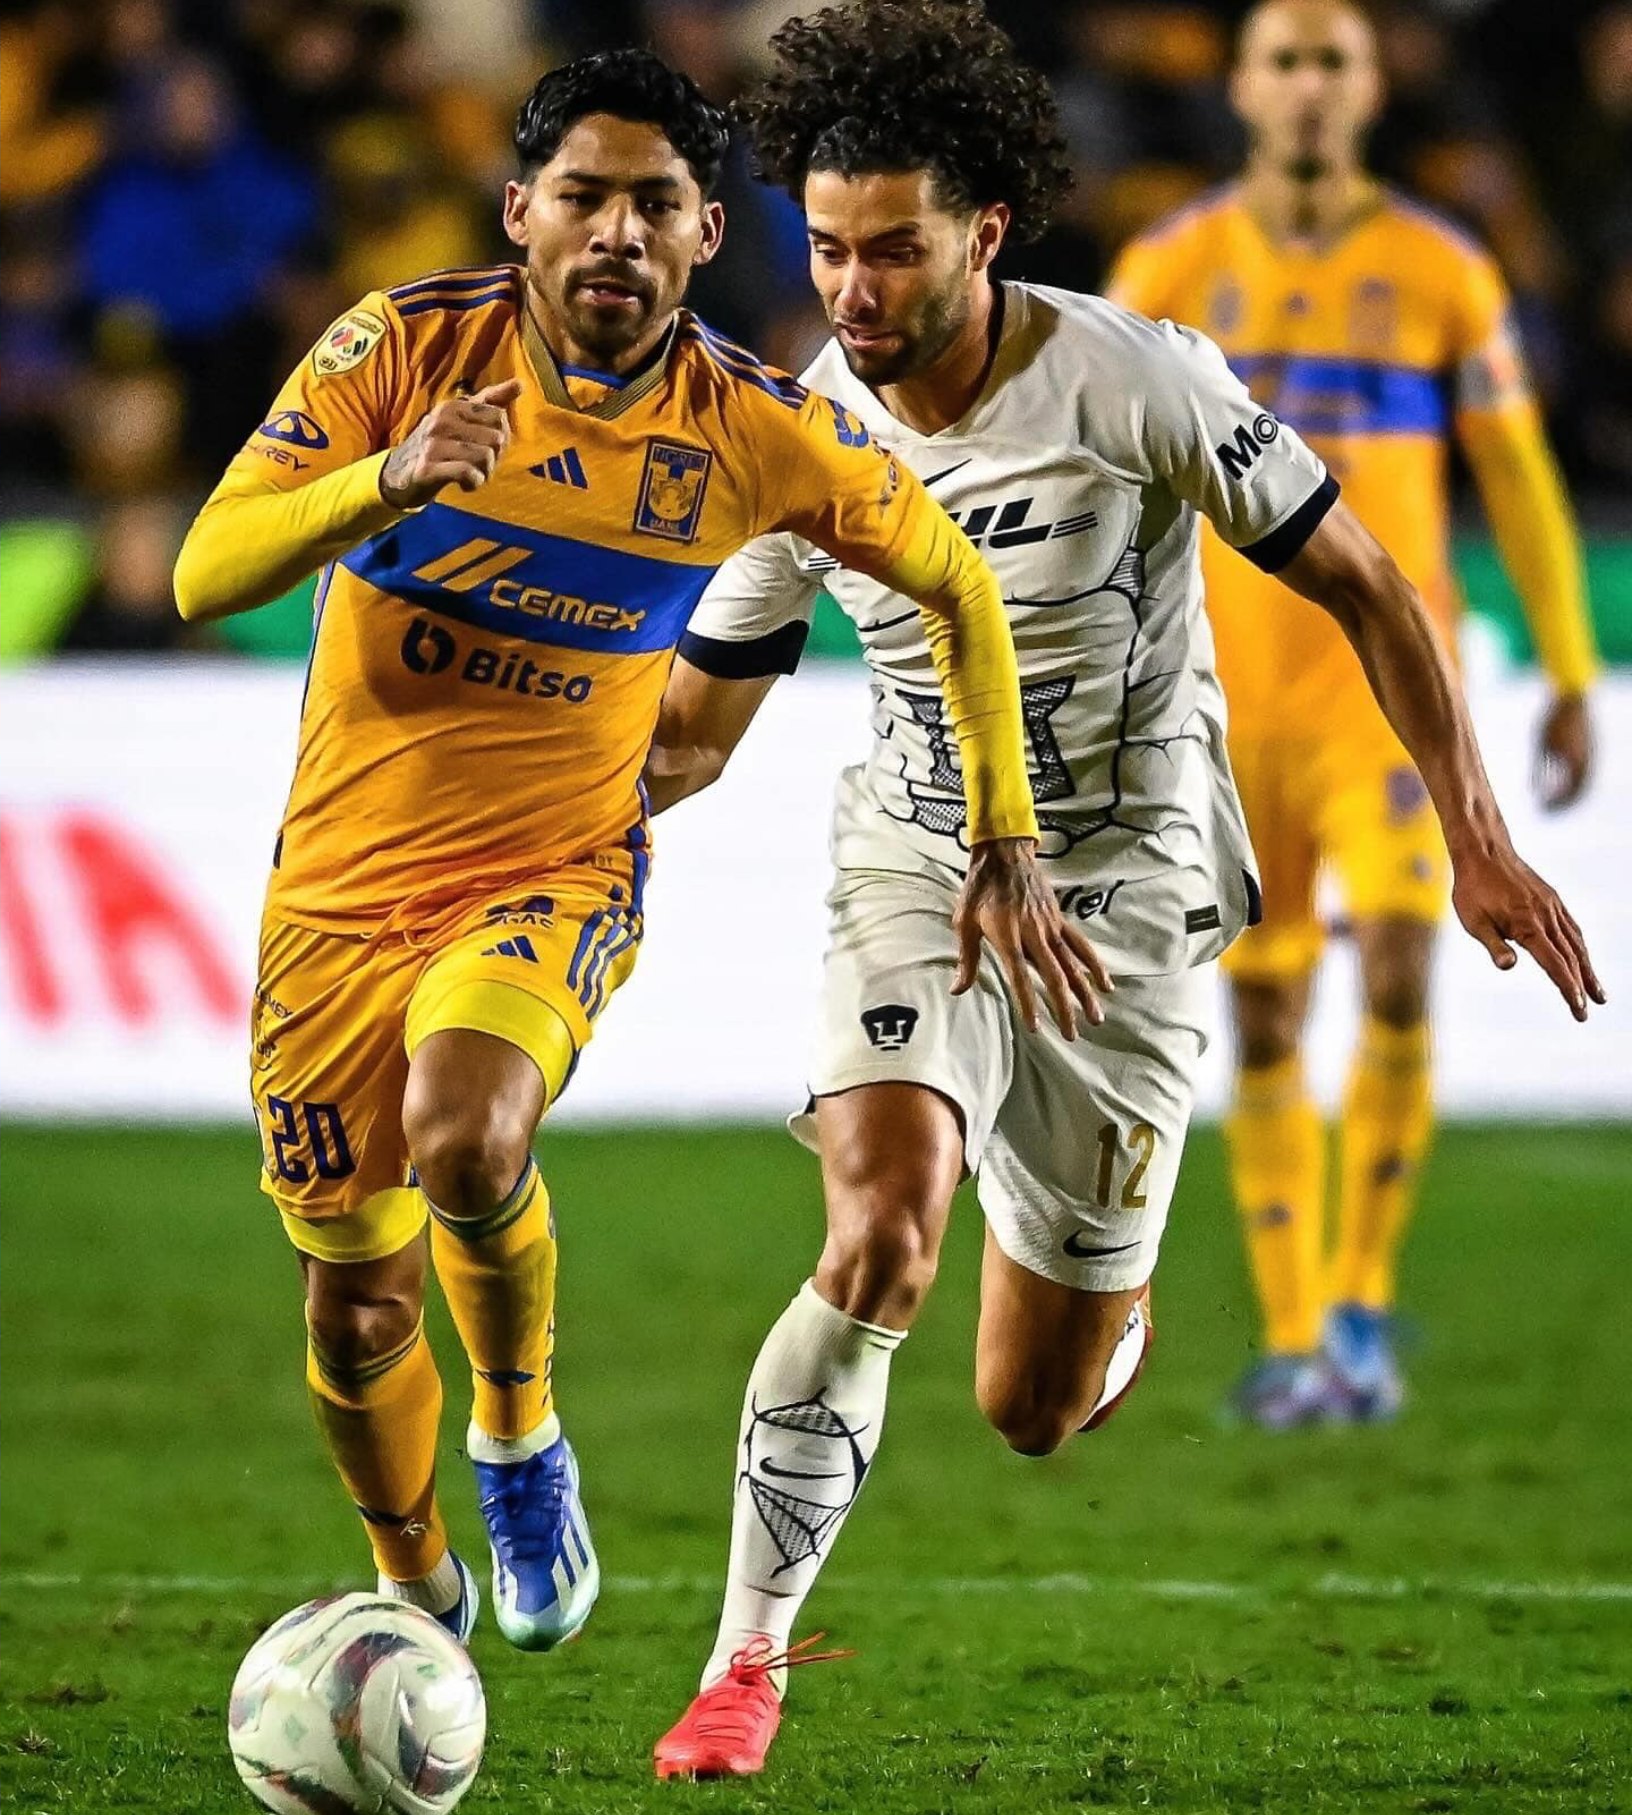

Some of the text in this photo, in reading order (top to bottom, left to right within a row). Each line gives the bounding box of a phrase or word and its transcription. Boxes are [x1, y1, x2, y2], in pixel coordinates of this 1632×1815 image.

[489, 579, 646, 631] CEMEX
[463, 649, 593, 703] Bitso
[267, 1094, 357, 1184] 20
[1096, 1122, 1156, 1209] 12
